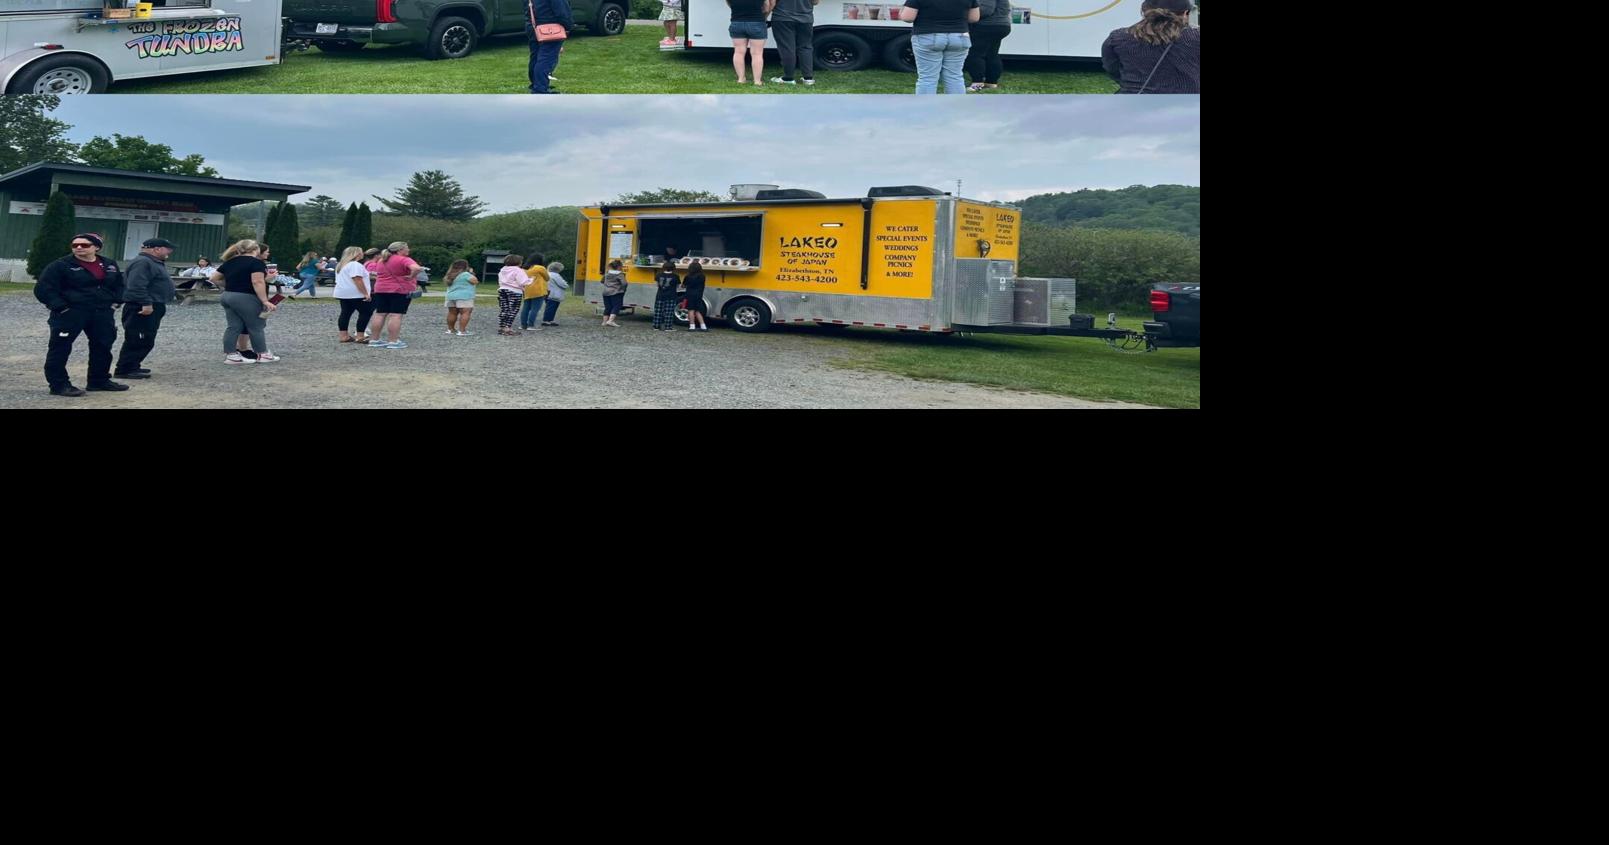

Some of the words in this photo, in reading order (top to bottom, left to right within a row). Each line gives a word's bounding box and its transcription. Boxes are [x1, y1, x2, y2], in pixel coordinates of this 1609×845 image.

[161, 17, 241, 35] FROZEN
[125, 31, 244, 59] TUNDRA
[780, 236, 838, 249] LAKEO
[775, 274, 838, 283] 423-543-4200
